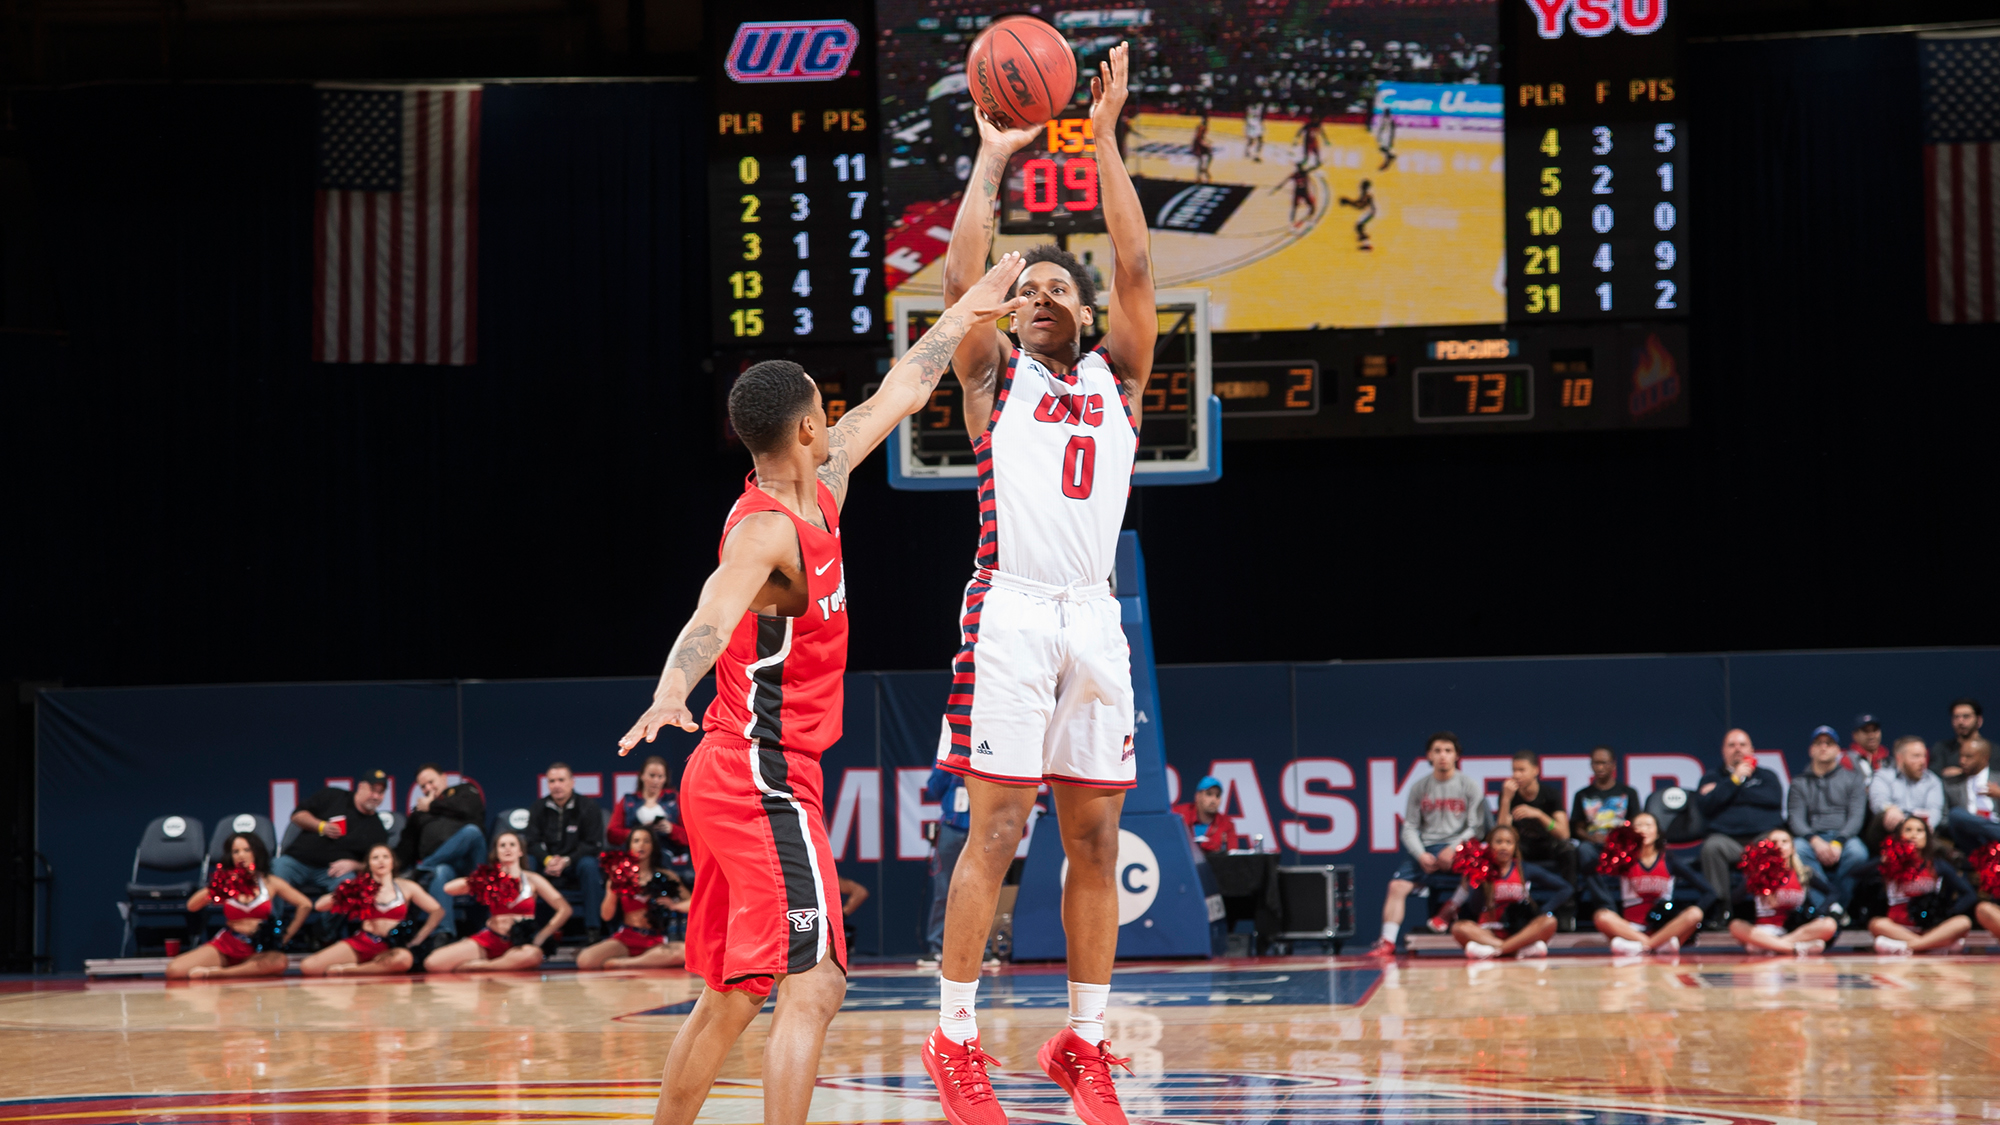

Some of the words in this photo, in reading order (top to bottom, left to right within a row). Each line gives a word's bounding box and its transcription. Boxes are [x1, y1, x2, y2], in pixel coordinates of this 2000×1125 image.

[1526, 0, 1668, 39] YSU
[729, 21, 857, 80] UIC
[1001, 58, 1036, 108] NCAA
[1519, 83, 1566, 106] PLR
[1596, 80, 1611, 104] F
[1628, 78, 1675, 103] PTS
[719, 113, 763, 134] PLR
[791, 111, 805, 133] F
[823, 109, 867, 132] PTS
[1539, 128, 1561, 157] 4
[1591, 125, 1613, 155] 3
[1653, 122, 1676, 153] 5
[738, 156, 760, 184] 0
[790, 154, 807, 183] 1
[832, 153, 867, 182] 11
[1023, 157, 1098, 212] 09
[1540, 167, 1562, 196] 5
[1591, 165, 1614, 194] 2
[1656, 162, 1674, 192] 1
[740, 194, 761, 223] 2
[790, 193, 811, 221] 3
[847, 191, 869, 220] 7
[1525, 206, 1562, 236] 10
[1591, 204, 1614, 234] 0
[1653, 201, 1677, 231] 0
[741, 233, 762, 261] 3
[792, 231, 809, 259] 1
[849, 229, 870, 258] 2
[1523, 245, 1561, 275] 21
[1592, 242, 1615, 273] 4
[1653, 240, 1677, 270] 9
[728, 270, 763, 299] 13
[791, 269, 812, 297] 4
[850, 267, 870, 296] 7
[1524, 284, 1561, 314] 31
[1595, 282, 1612, 312] 1
[1654, 279, 1677, 310] 2
[729, 308, 764, 337] 15
[793, 307, 813, 335] 3
[851, 305, 872, 334] 9
[1285, 368, 1314, 407] 2
[1355, 385, 1376, 412] 2
[1453, 373, 1507, 414] 73
[1561, 378, 1593, 407] 10
[1033, 391, 1104, 428] UIC
[1061, 434, 1096, 500] 0
[787, 908, 818, 931] Y
